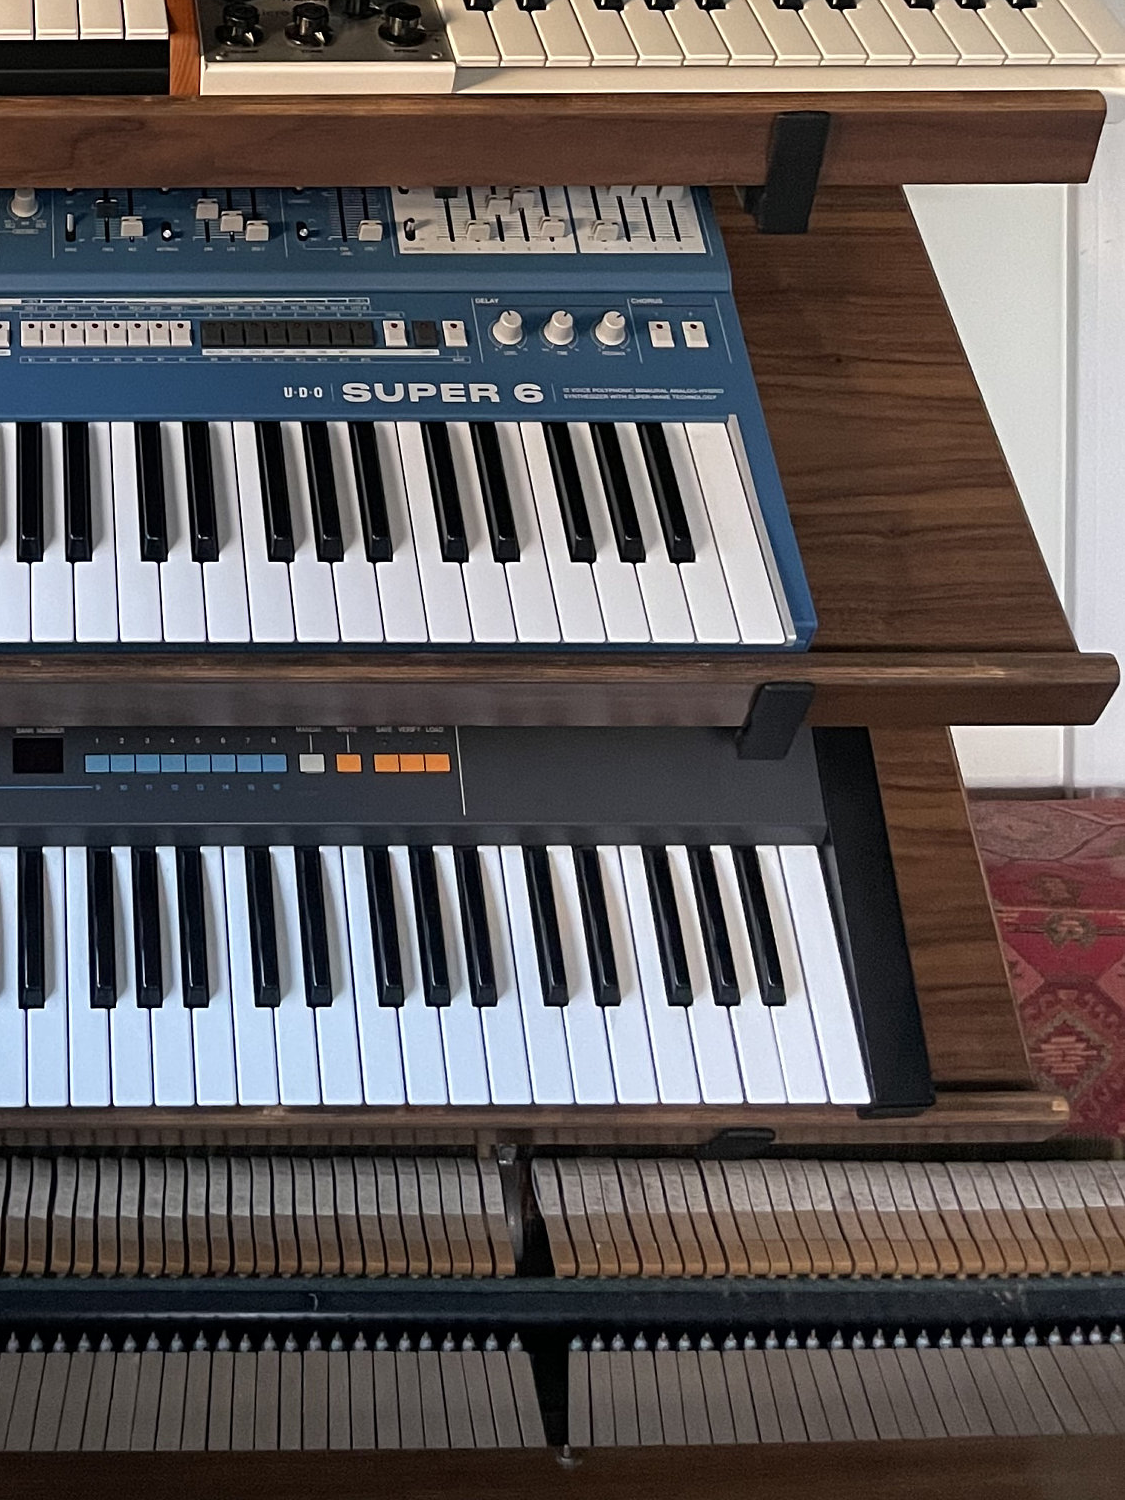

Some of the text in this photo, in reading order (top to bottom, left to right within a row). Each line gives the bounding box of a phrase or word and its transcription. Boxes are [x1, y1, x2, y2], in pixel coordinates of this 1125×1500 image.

[630, 297, 664, 305] CHORUS
[341, 382, 545, 404] SUPER 6
